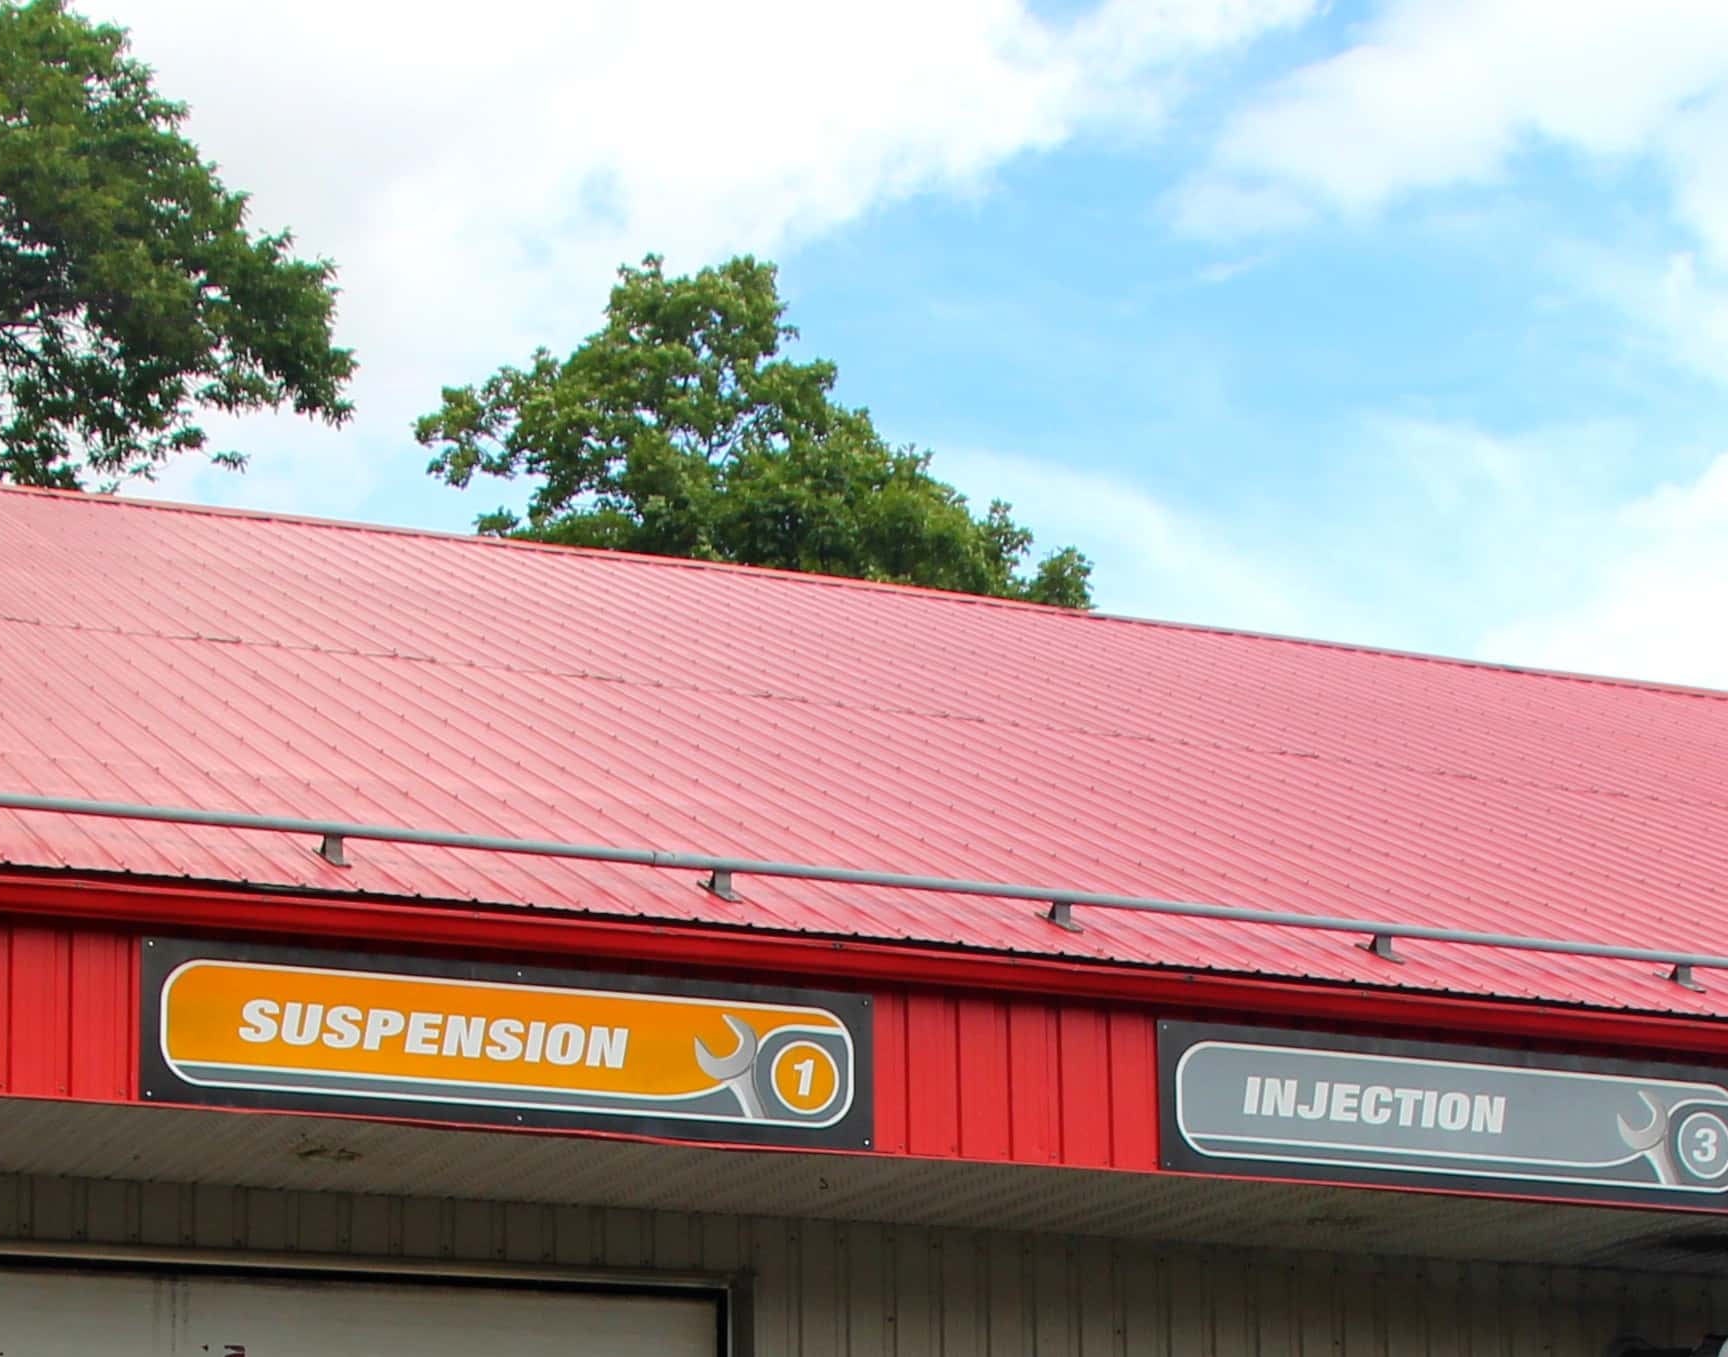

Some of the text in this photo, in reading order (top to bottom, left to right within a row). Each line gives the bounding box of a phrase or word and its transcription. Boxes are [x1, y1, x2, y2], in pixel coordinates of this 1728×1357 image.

[239, 999, 629, 1070] SUSPENSION
[790, 1059, 815, 1097] 1
[1242, 1076, 1506, 1135] INJECTION
[1691, 1126, 1720, 1164] 3
